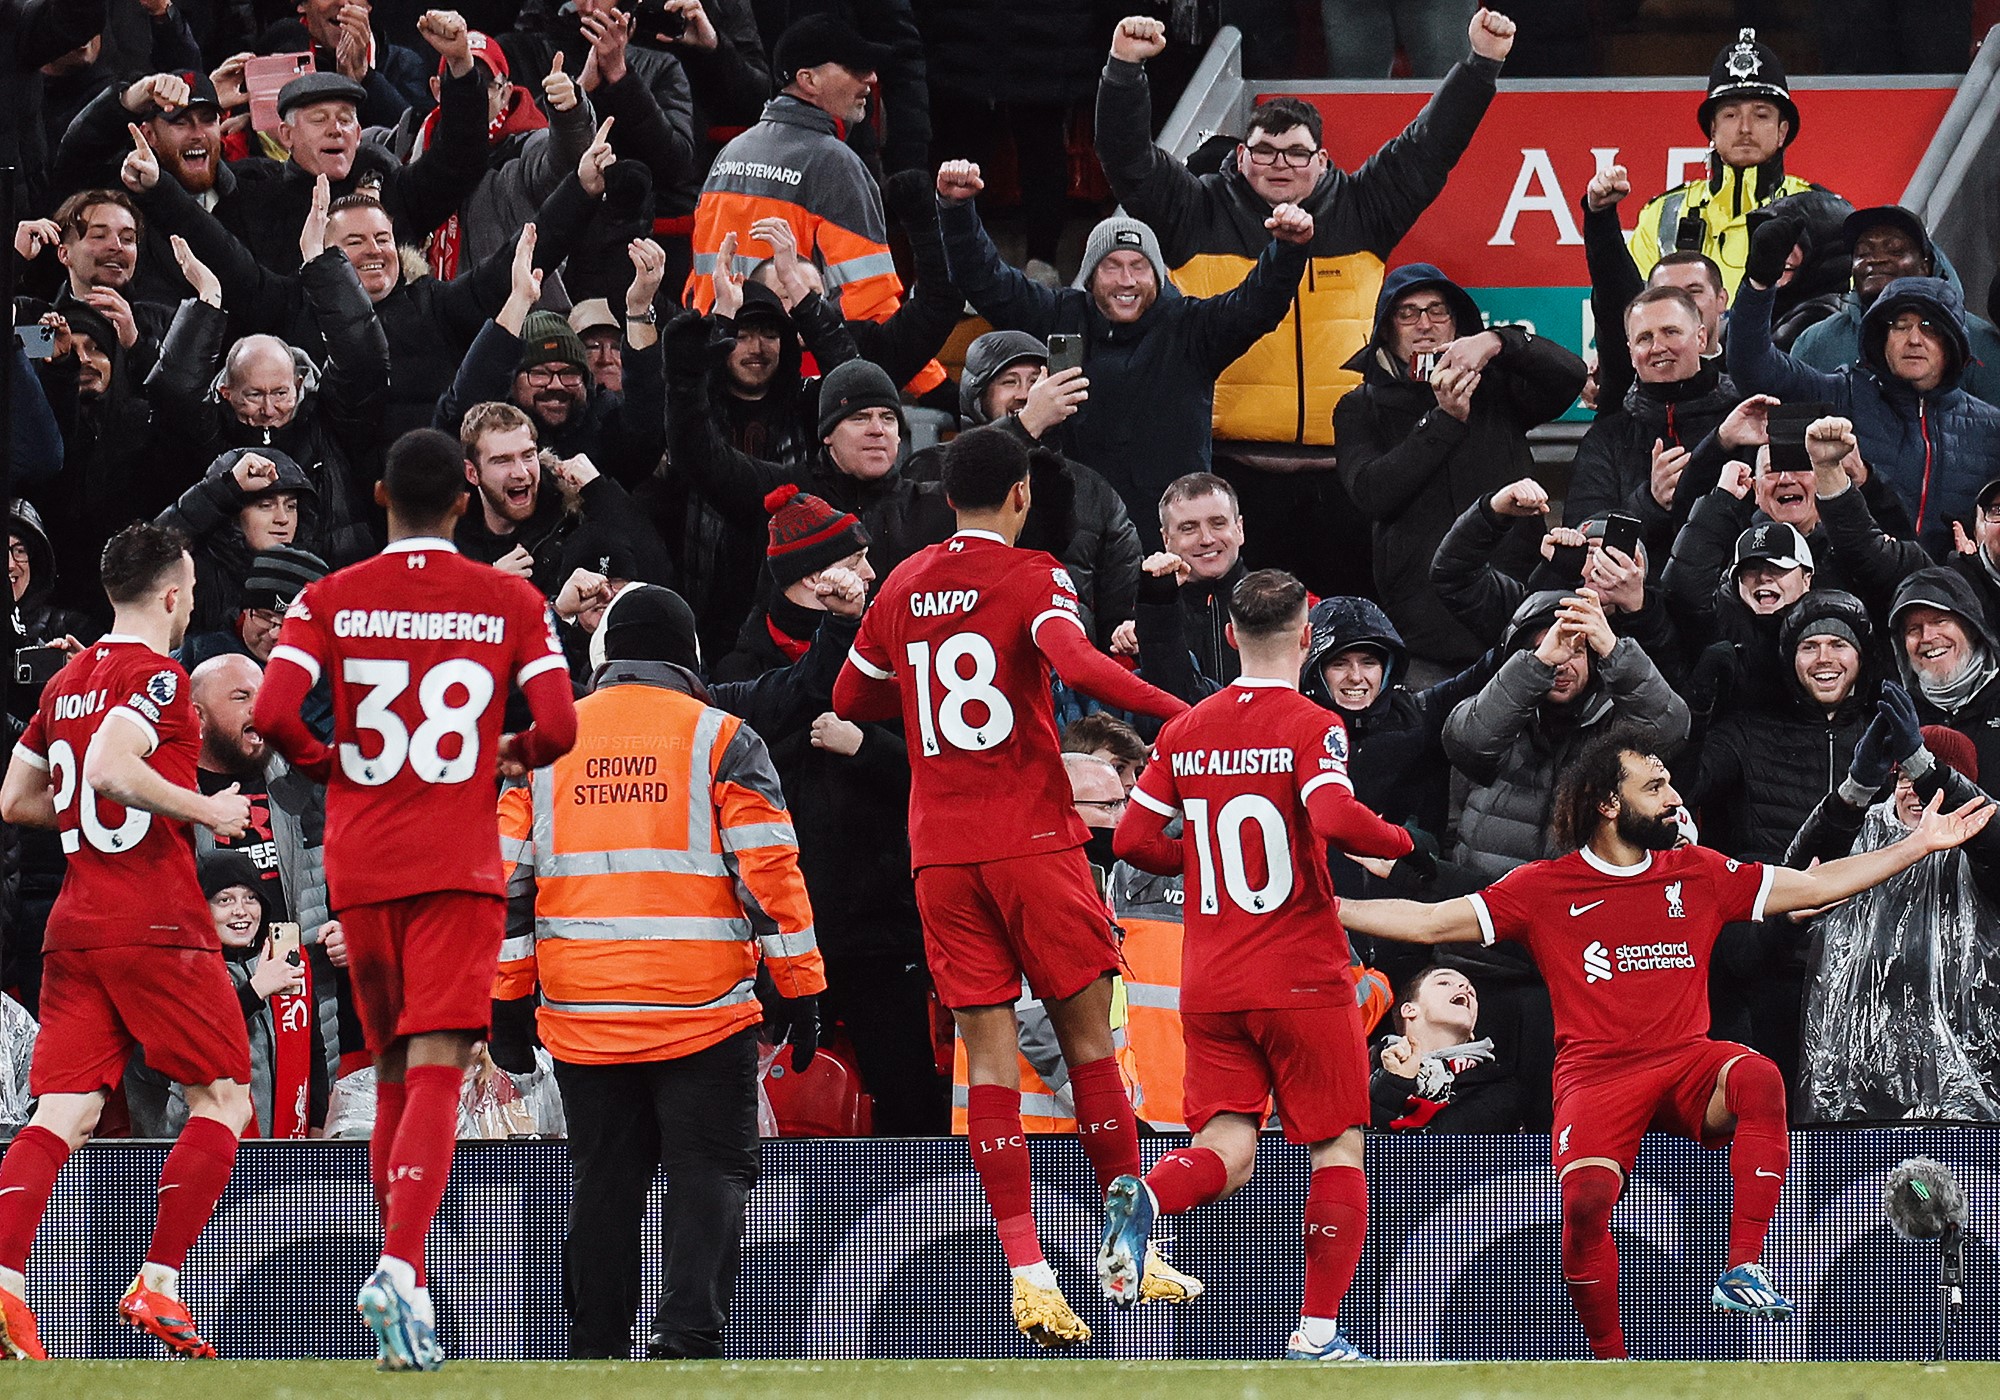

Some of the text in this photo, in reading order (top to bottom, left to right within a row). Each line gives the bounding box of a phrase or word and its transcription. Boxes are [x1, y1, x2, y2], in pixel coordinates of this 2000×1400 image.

[745, 161, 802, 186] STEWARD
[910, 589, 979, 618] GAKPO
[333, 609, 505, 645] GRAVENBERCH
[54, 689, 97, 721] DIOO
[906, 631, 1016, 757] 18
[338, 657, 495, 786] 38
[586, 756, 657, 779] CROWD
[1171, 749, 1206, 778] MAC
[1207, 747, 1295, 776] ALLISTER
[574, 782, 668, 806] STEWARD
[1182, 793, 1294, 915] 10
[1615, 941, 1689, 960] standard
[1617, 954, 1696, 973] chartered
[1079, 1118, 1119, 1135] LFC
[979, 1135, 1023, 1154] LFC
